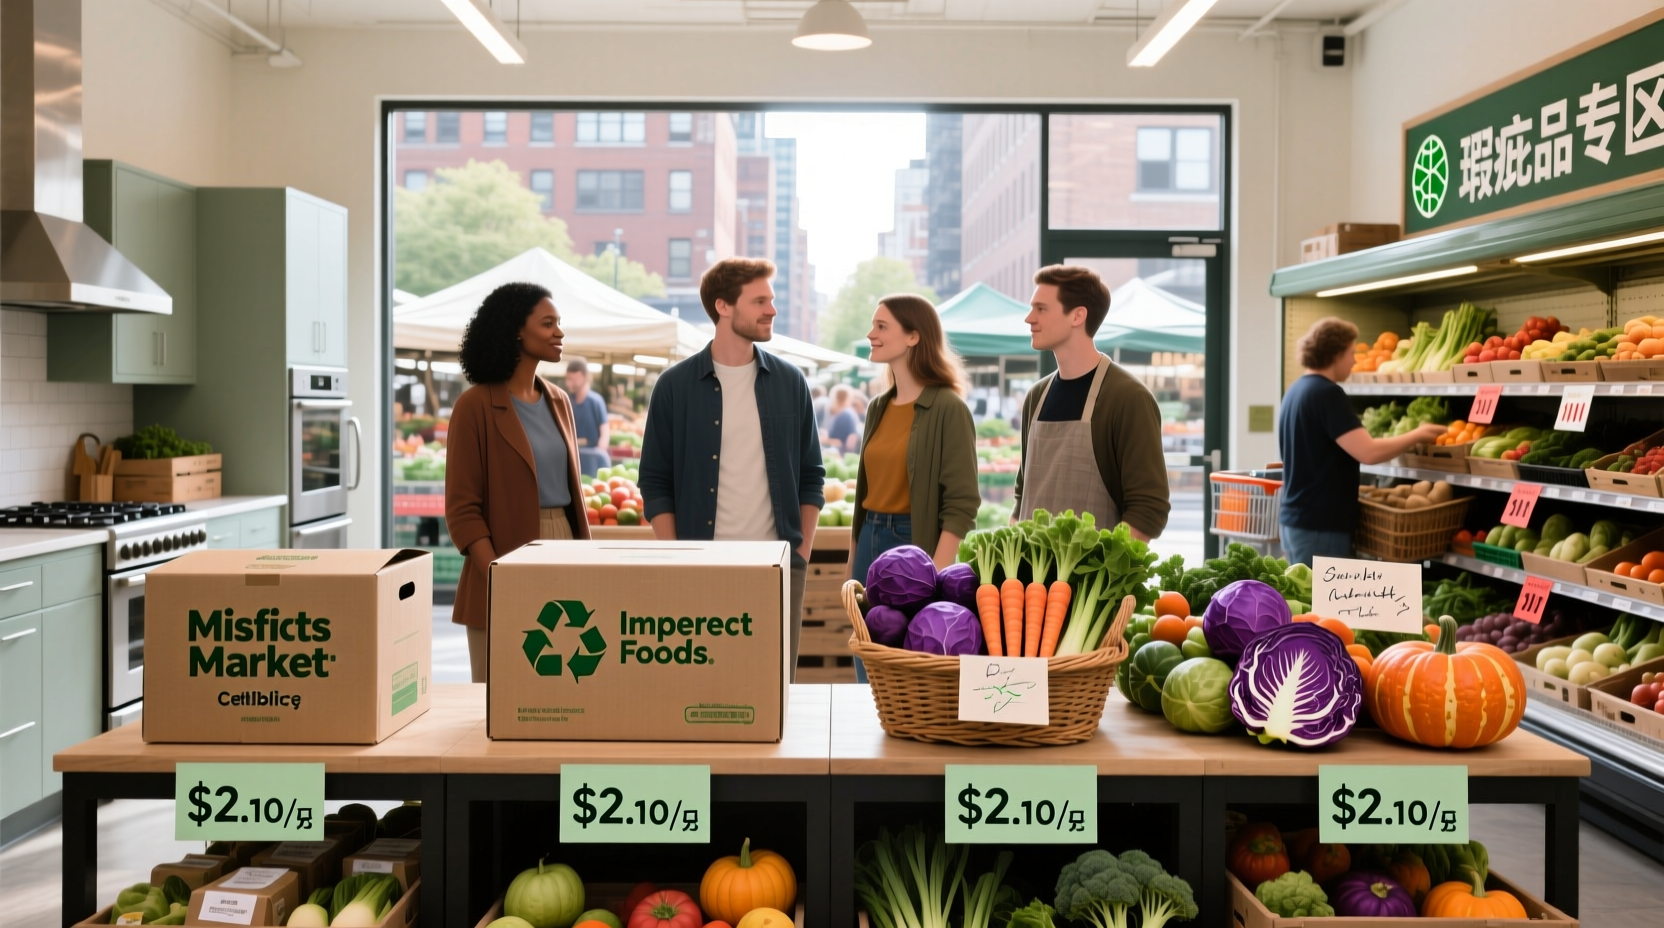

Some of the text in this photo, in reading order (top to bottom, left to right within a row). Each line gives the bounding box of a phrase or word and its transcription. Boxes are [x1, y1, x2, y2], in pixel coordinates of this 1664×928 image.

[1458, 60, 1664, 203] 瑕疵品专区
[188, 607, 331, 642] Misficts
[620, 610, 753, 643] Imperect
